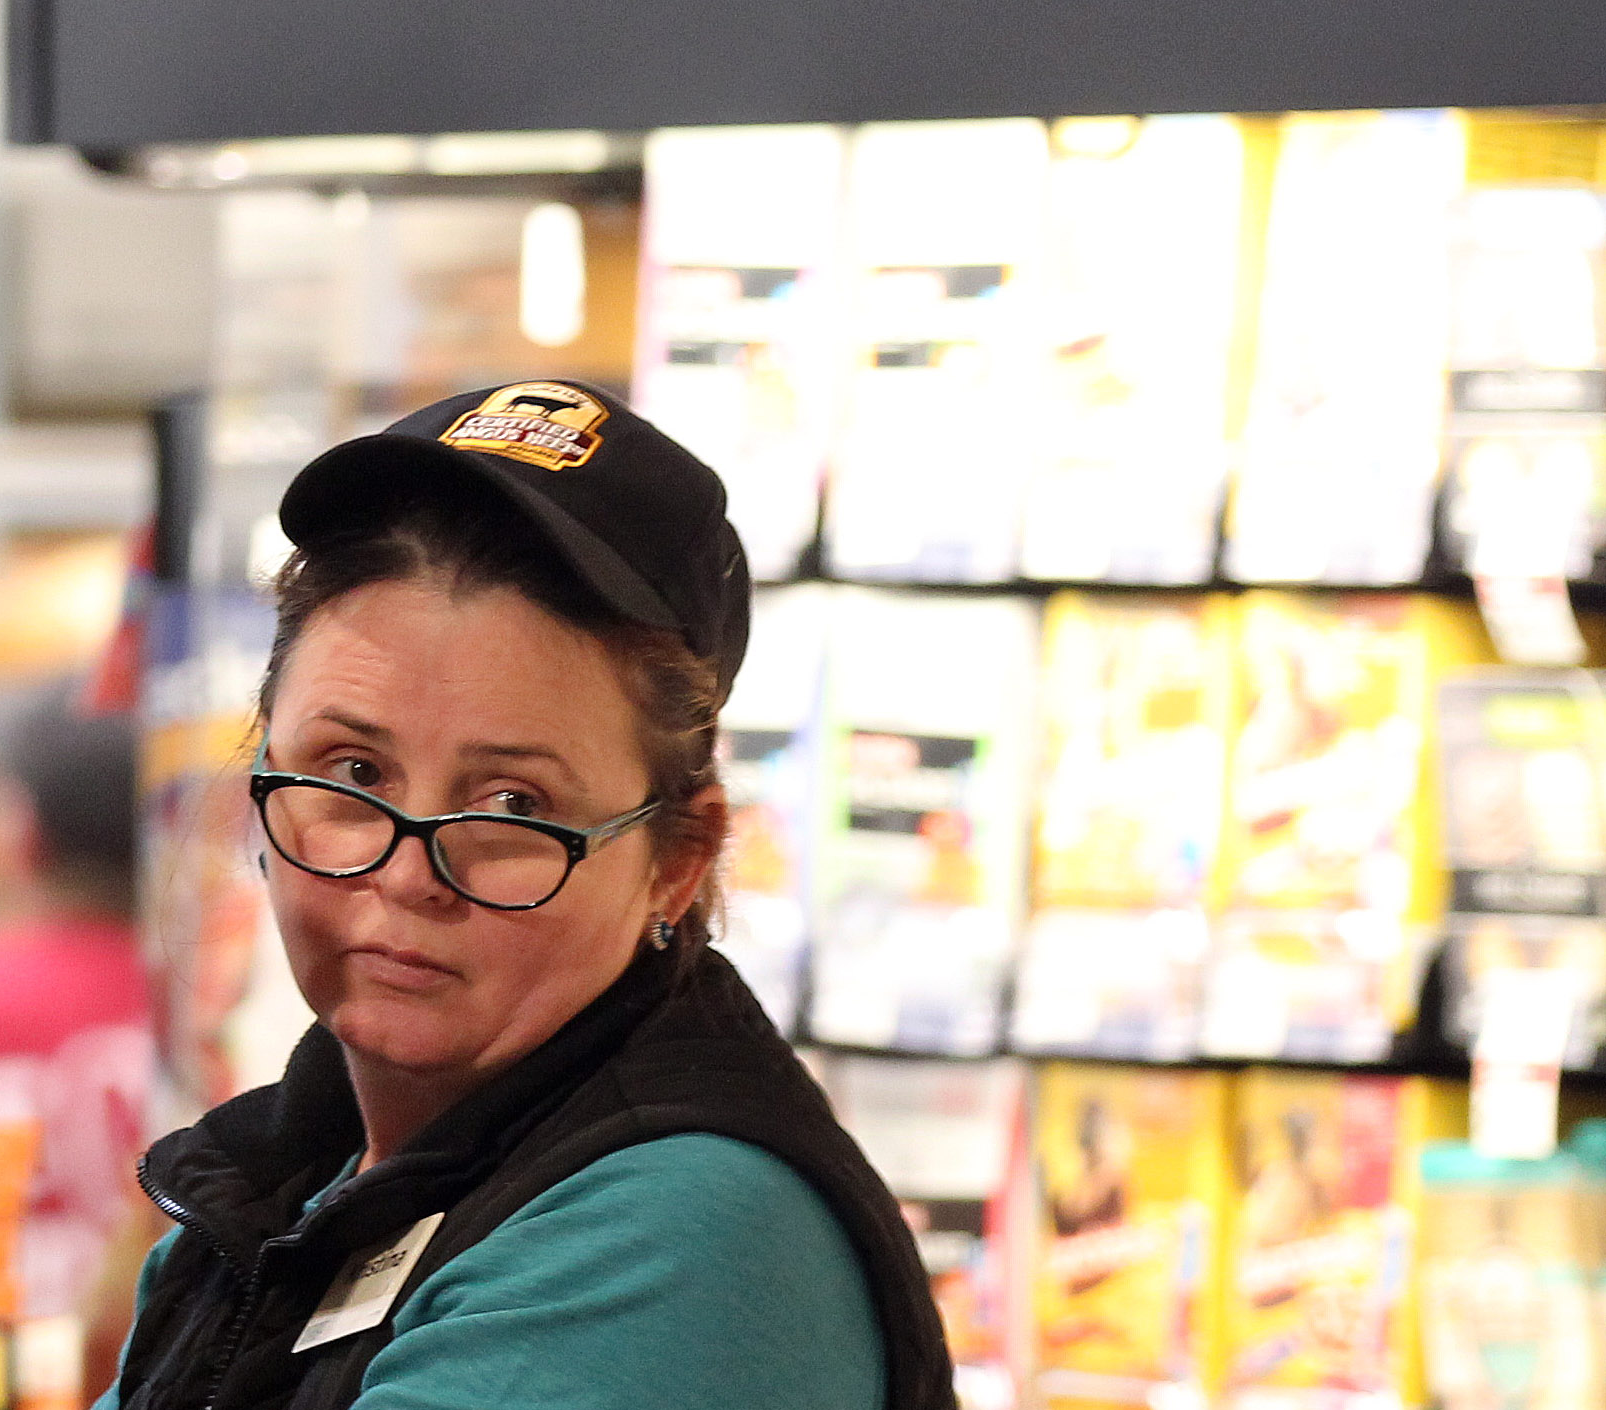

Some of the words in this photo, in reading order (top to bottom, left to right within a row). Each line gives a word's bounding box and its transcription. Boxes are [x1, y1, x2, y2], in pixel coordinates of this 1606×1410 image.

[448, 426, 523, 442] ANGUS
[522, 430, 589, 457] BEEF
[463, 415, 582, 442] CERTIFIED
